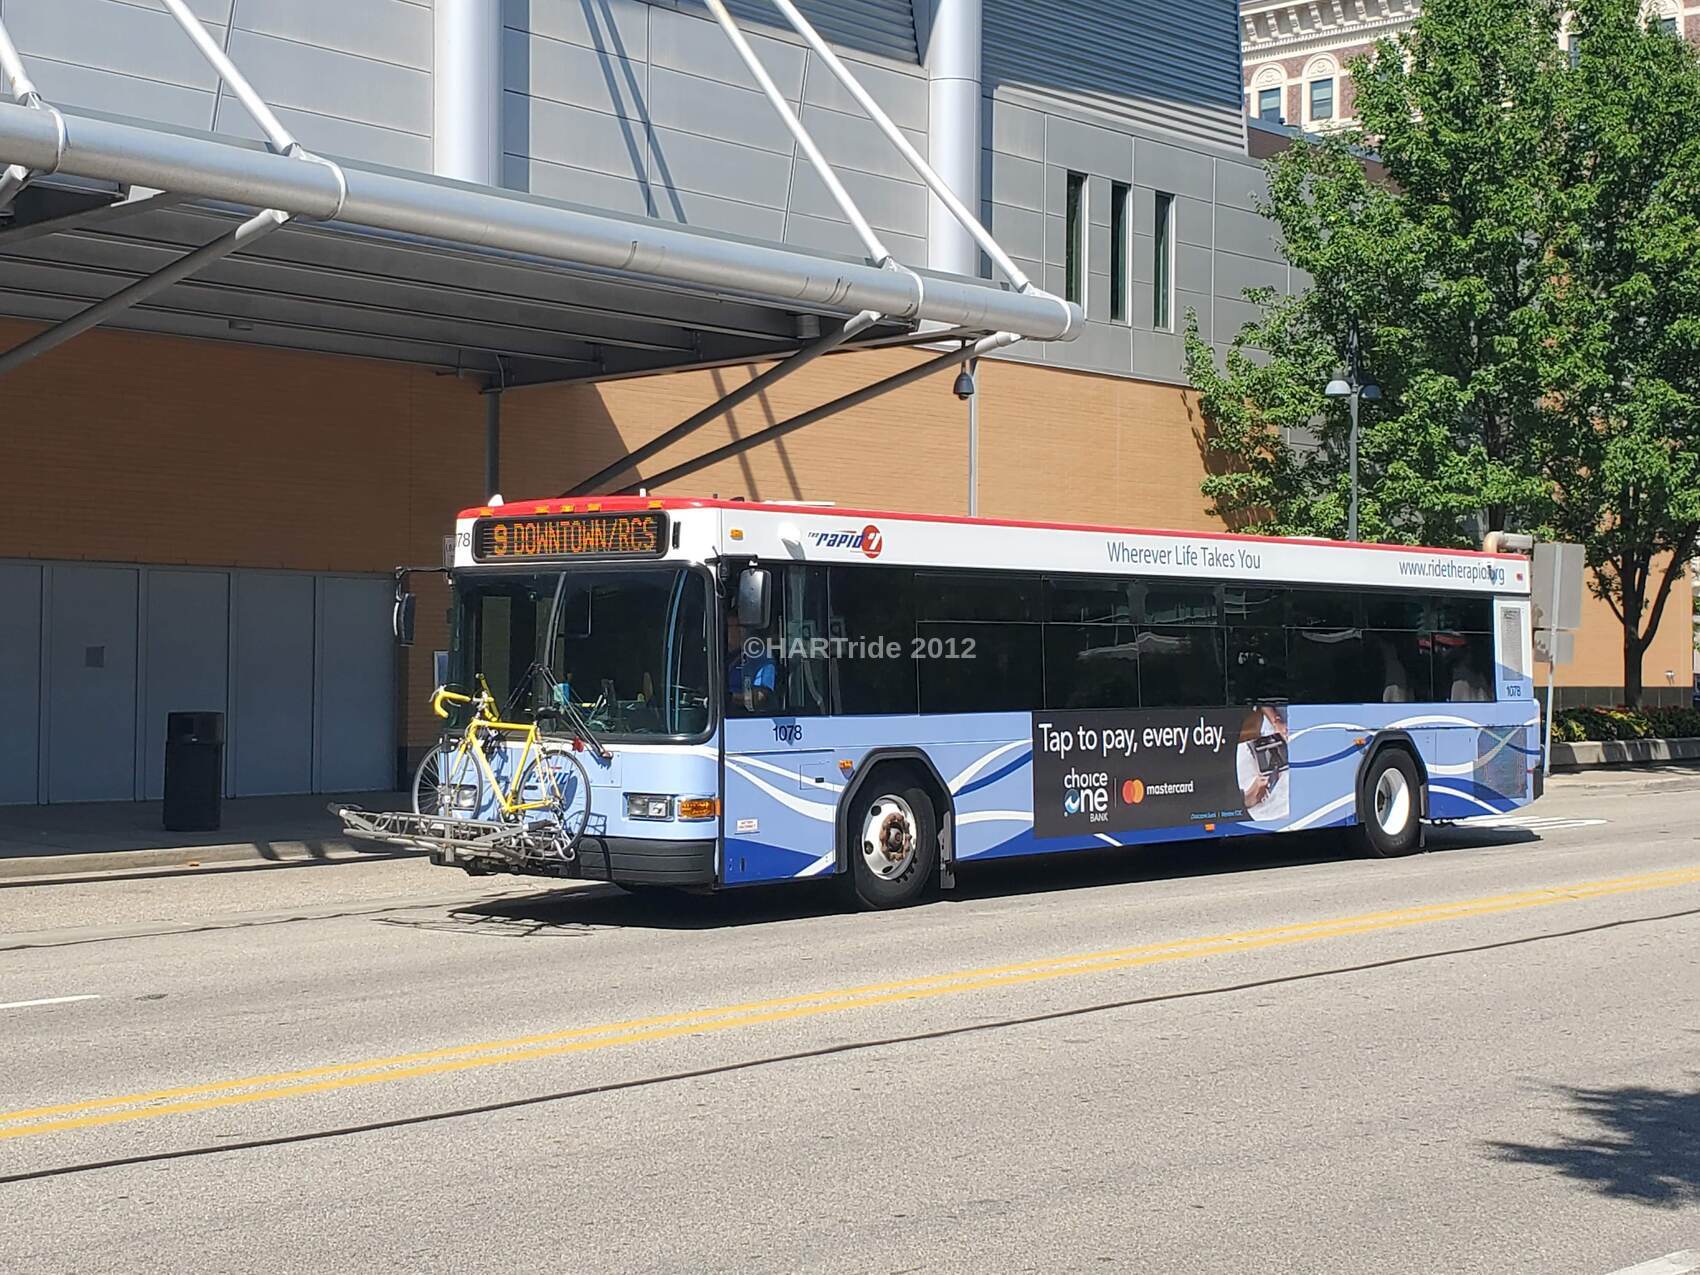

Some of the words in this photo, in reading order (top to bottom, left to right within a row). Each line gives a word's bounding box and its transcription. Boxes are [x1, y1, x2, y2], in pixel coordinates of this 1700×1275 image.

[494, 523, 508, 556] 9
[513, 516, 656, 556] DOWNTOWN/RCS
[1107, 541, 1172, 567] Wherever
[1174, 543, 1198, 567] Life
[1200, 545, 1235, 569] Takes
[1237, 548, 1261, 570] You
[772, 724, 803, 742] 1078
[1038, 722, 1073, 759] Tap
[1077, 725, 1098, 750] to
[1102, 727, 1138, 757] pay,
[1142, 726, 1189, 754] every
[1193, 717, 1226, 753] day.
[1064, 767, 1108, 788] choice
[1146, 780, 1194, 797] mastercard
[1089, 812, 1109, 823] BANK
